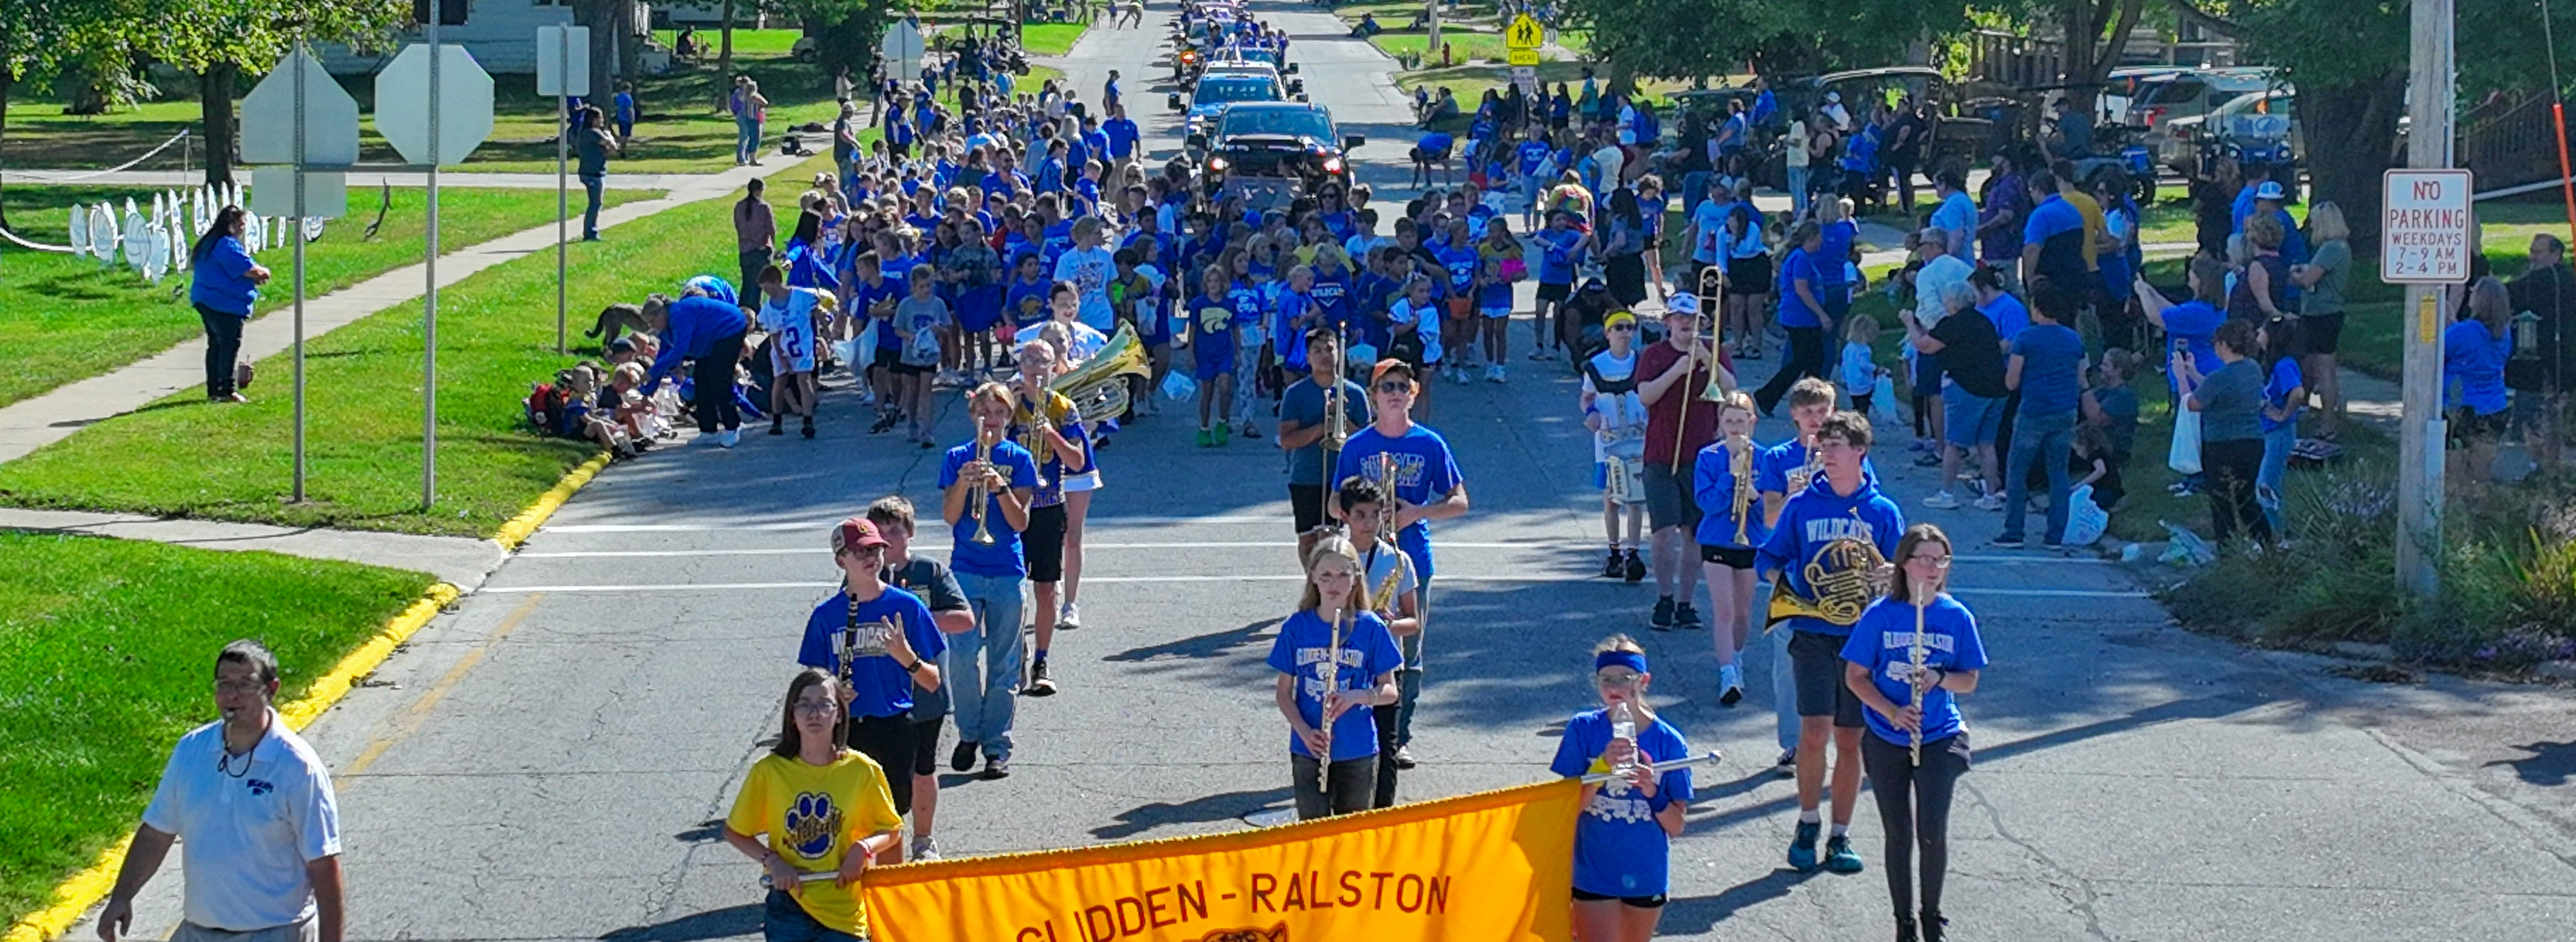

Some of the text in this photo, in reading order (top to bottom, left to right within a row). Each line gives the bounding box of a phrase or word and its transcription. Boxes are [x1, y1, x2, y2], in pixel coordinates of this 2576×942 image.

[2414, 181, 2441, 200] NO
[2389, 209, 2465, 229] PARKING
[2392, 232, 2462, 246] WEEKDAYS
[2435, 248, 2455, 260] AM
[2438, 262, 2458, 275] PM
[785, 326, 804, 358] 2
[1251, 870, 1452, 916] RALSTON
